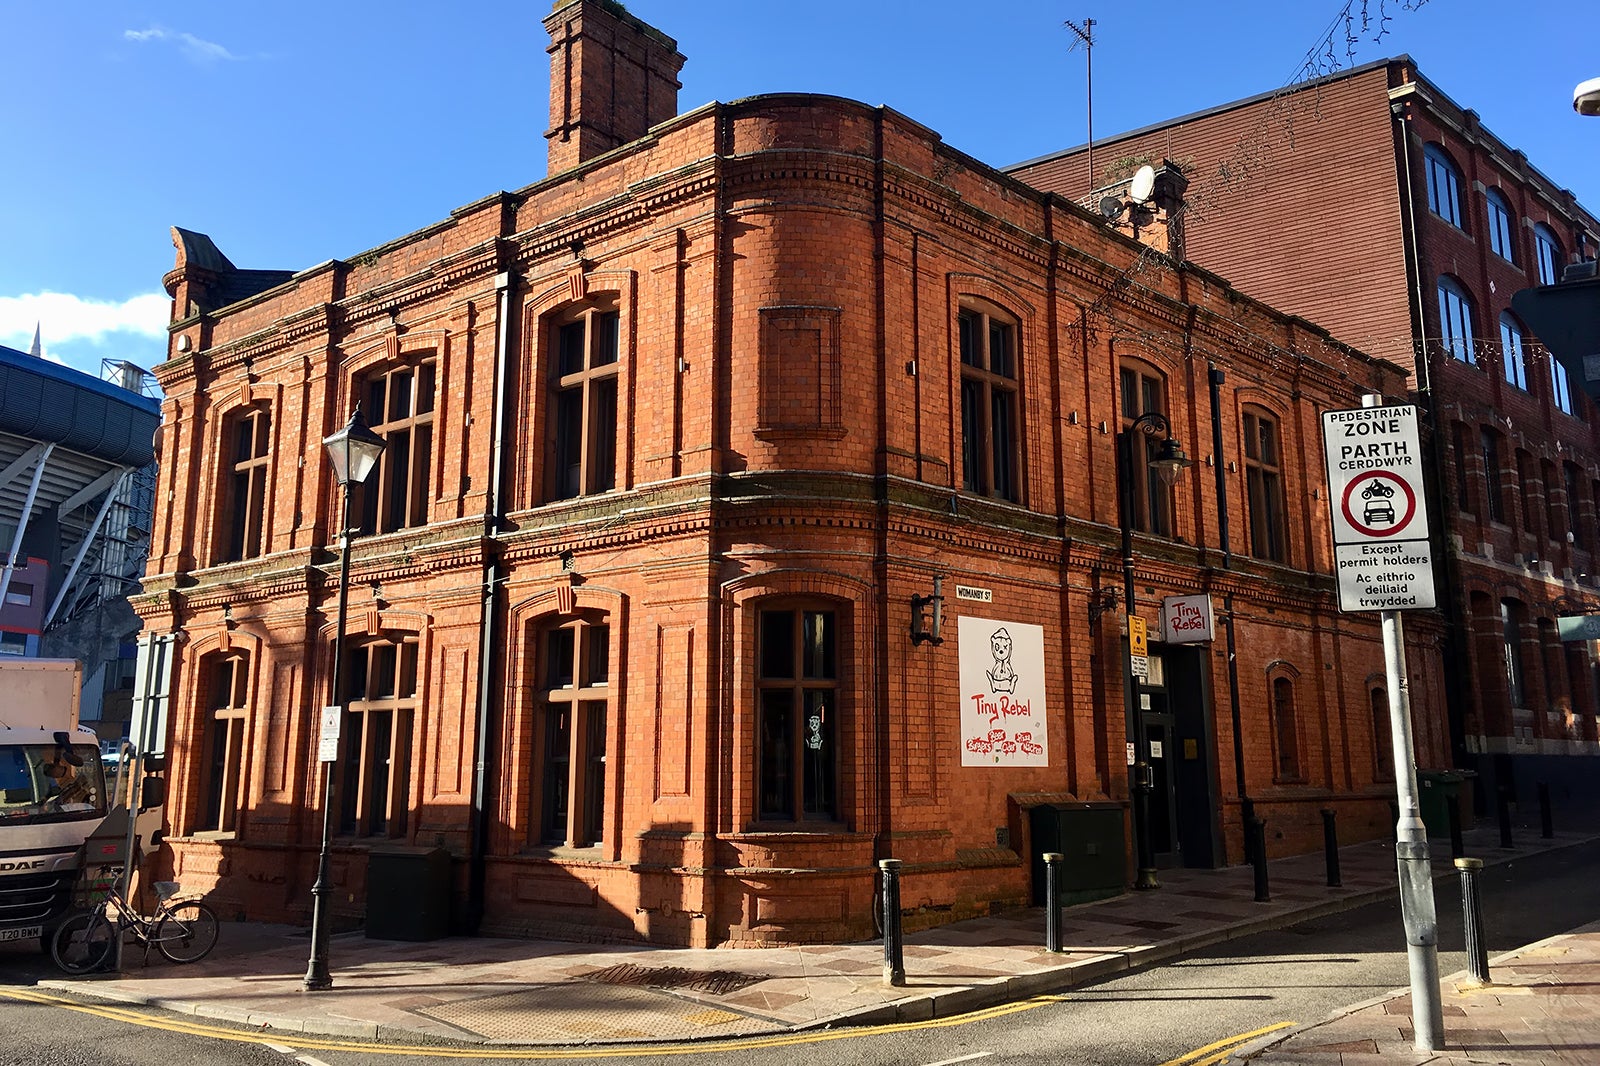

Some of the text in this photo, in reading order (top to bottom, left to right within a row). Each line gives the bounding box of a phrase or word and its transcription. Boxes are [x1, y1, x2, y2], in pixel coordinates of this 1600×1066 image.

[1331, 407, 1412, 422] PEDESTRIAN
[1344, 419, 1400, 437] ZONE
[1341, 441, 1407, 459] PARTH
[1339, 456, 1412, 470] CERDDWYR
[1362, 544, 1403, 555] Except
[1340, 555, 1428, 569] permit holders
[1356, 572, 1415, 583] Ac eithrio
[958, 587, 984, 599] WOMANBY
[1365, 584, 1408, 595] deiliaid
[1359, 595, 1416, 607] trwydded
[1172, 602, 1202, 620] Tiny
[1171, 616, 1205, 634] Rebel
[971, 694, 1031, 725] Tiny Rebel
[1, 860, 45, 870] DAF
